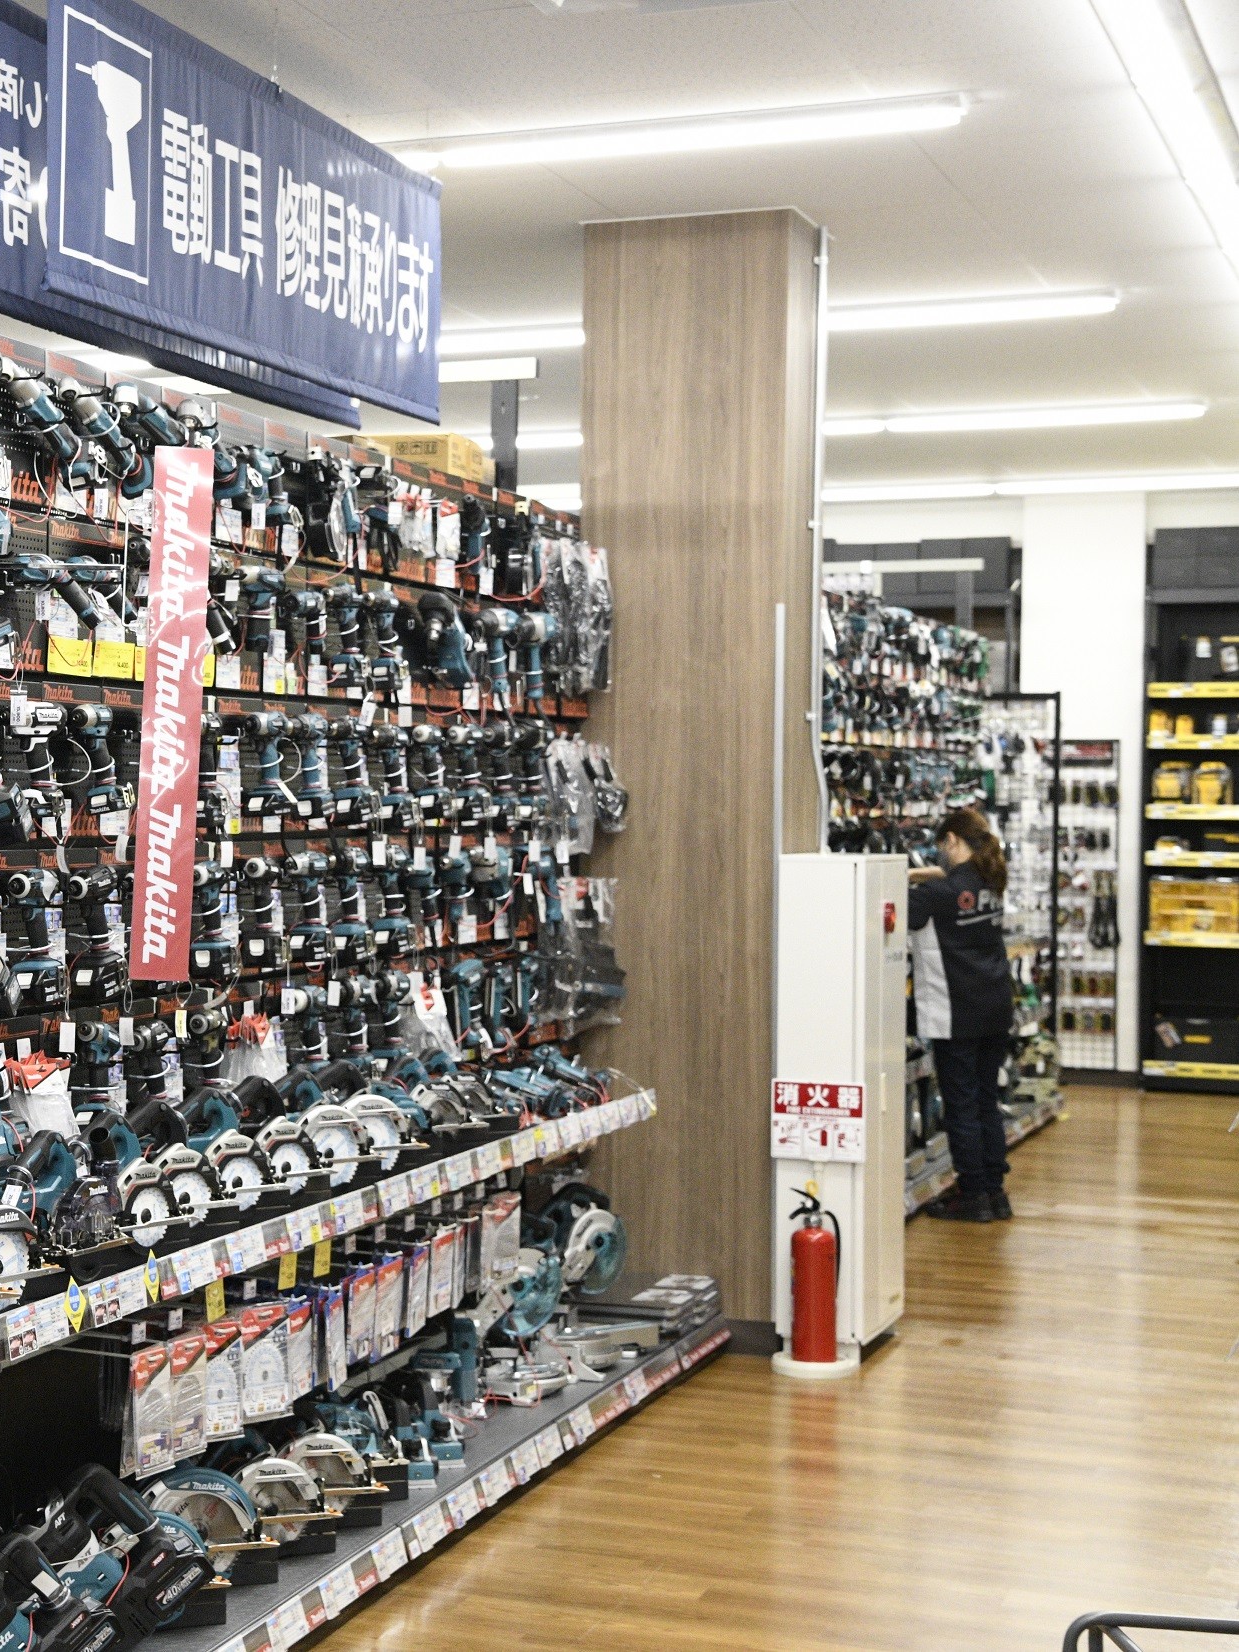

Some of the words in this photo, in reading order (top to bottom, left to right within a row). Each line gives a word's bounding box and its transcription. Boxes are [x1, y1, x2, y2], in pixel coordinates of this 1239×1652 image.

[161, 107, 264, 288] 電動工具
[776, 1082, 861, 1110] 消火器
